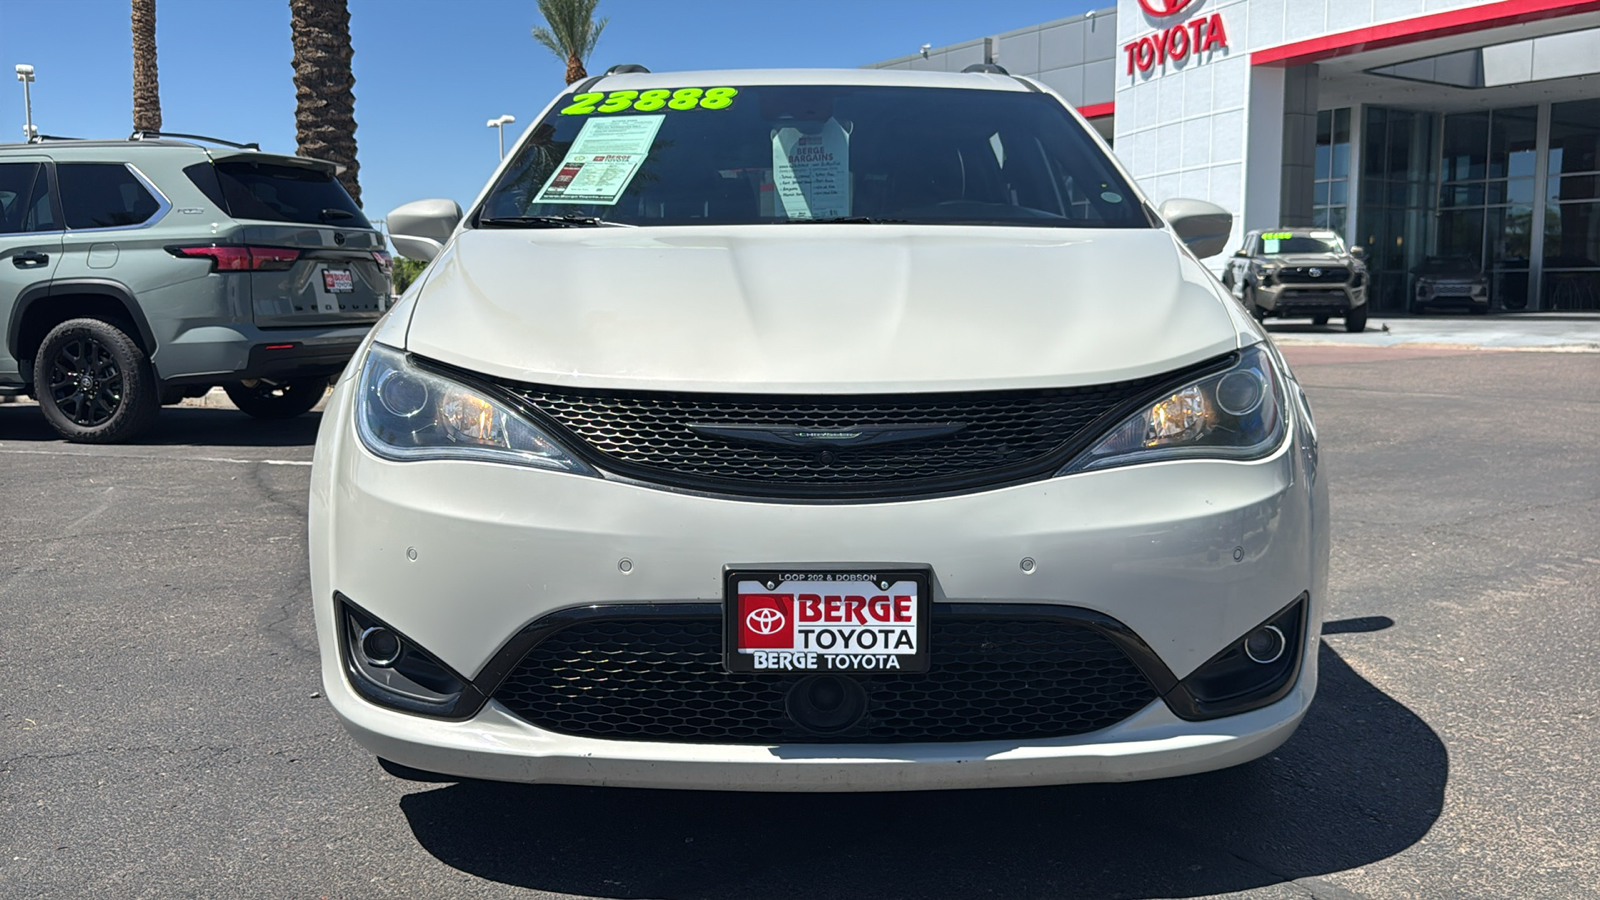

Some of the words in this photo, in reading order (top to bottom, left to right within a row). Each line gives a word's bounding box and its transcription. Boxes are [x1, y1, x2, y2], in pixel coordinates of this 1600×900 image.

[1124, 13, 1227, 76] TOYOTA
[561, 87, 738, 115] 23888
[788, 153, 834, 163] BARGAINS
[797, 147, 825, 155] BERGE
[798, 594, 912, 626] BERGE
[798, 629, 915, 650] TOYOTA
[753, 651, 818, 671] BERGE
[824, 654, 901, 670] TOYOTA
